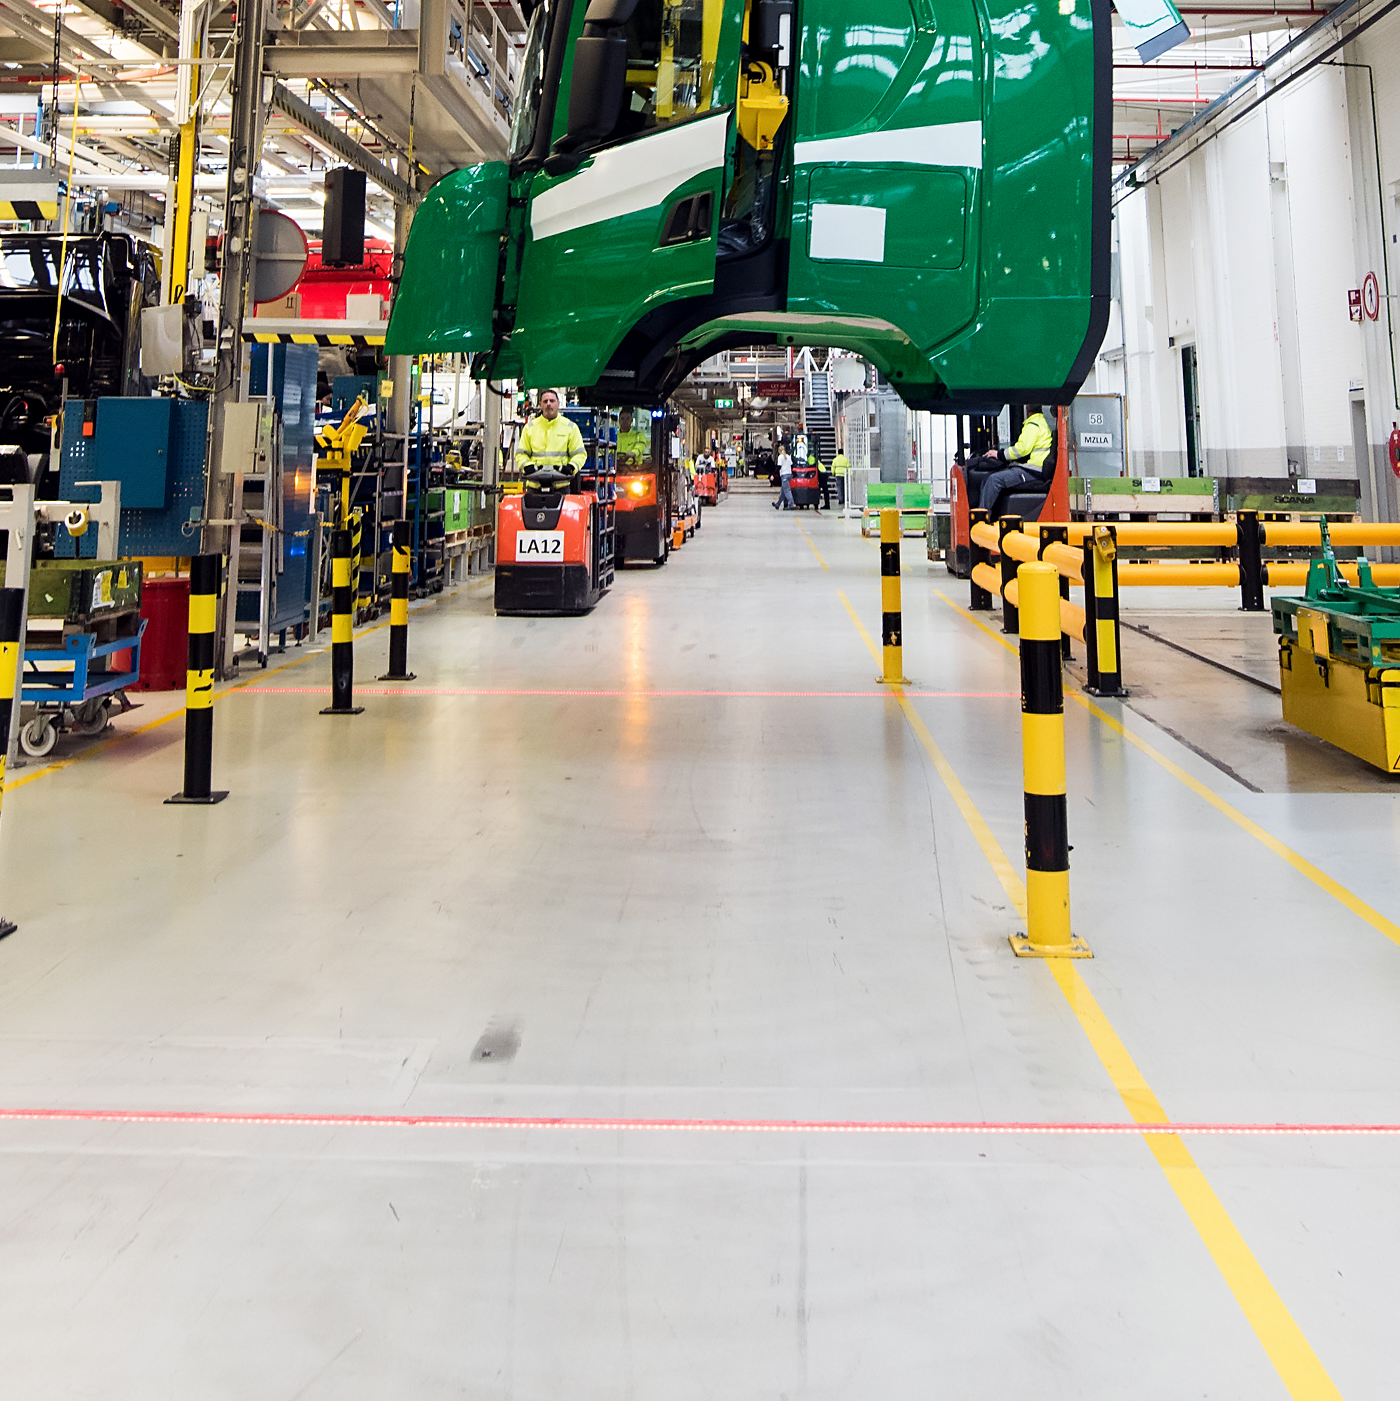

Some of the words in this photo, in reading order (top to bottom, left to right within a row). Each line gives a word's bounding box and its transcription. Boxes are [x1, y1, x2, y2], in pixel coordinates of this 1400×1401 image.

[1090, 414, 1103, 424] 58
[1084, 436, 1109, 444] MZLLA
[519, 539, 561, 554] LA12
